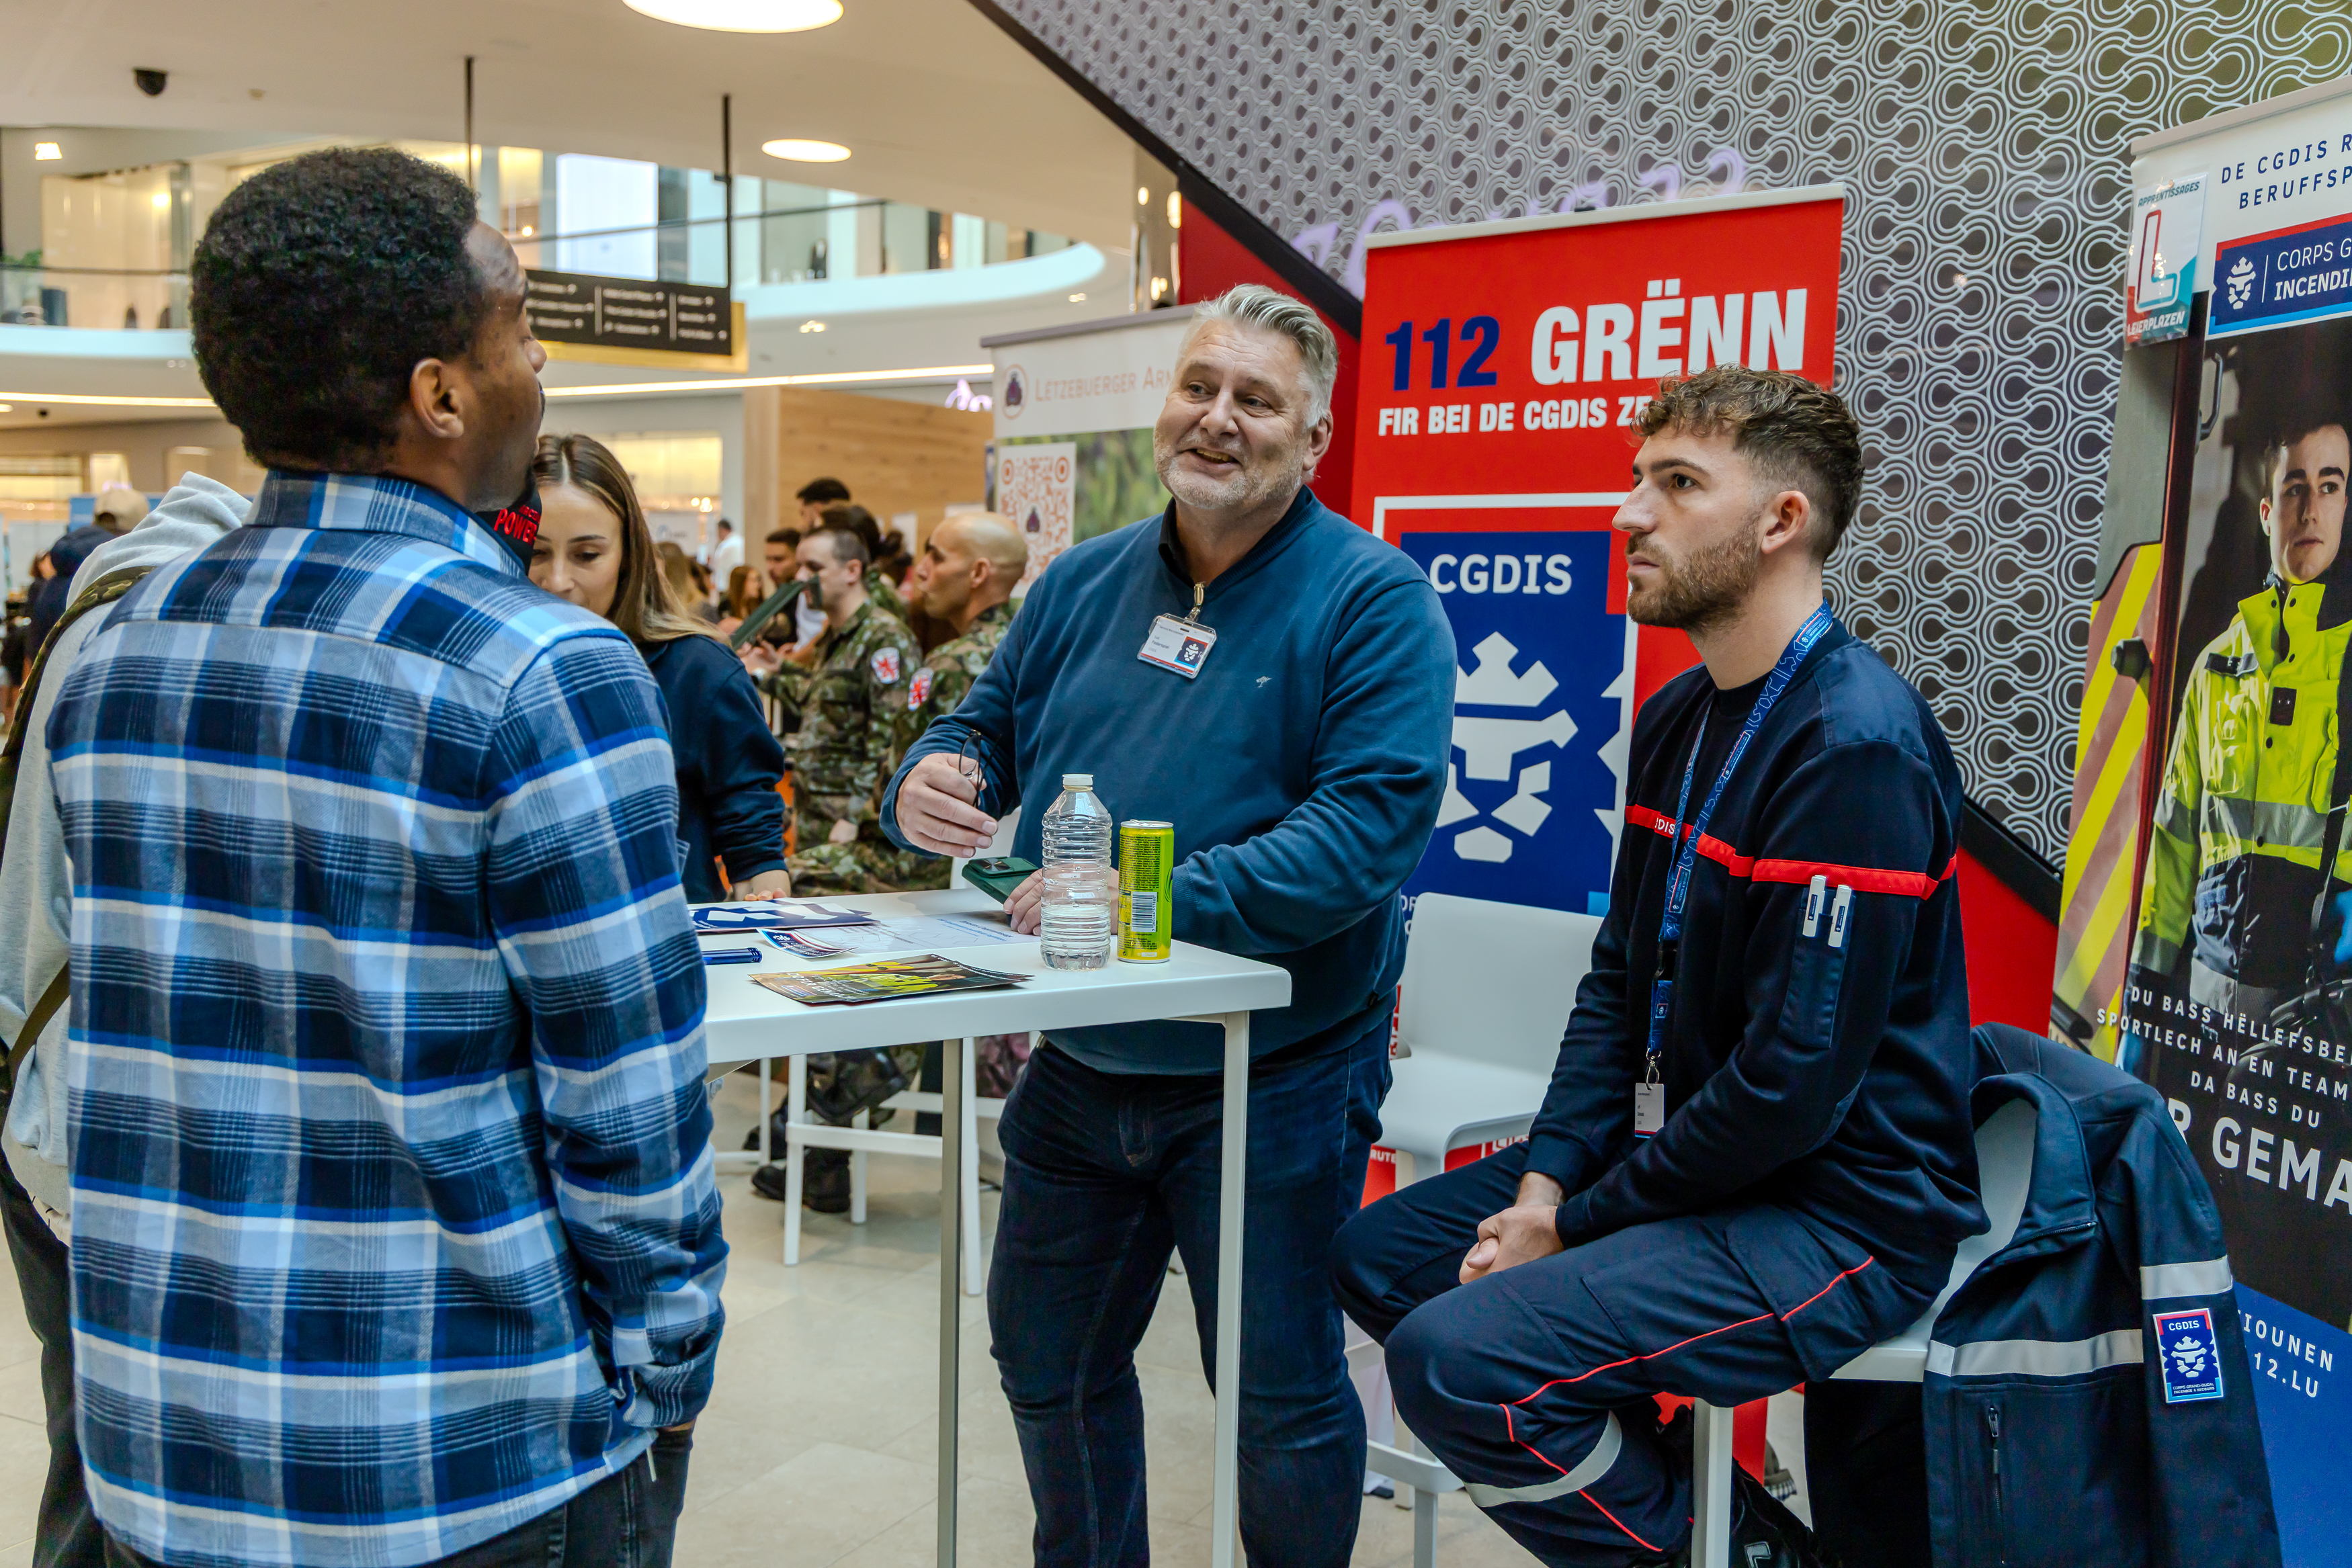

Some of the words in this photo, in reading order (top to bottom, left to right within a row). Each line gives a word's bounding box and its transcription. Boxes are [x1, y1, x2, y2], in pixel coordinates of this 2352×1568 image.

[2222, 163, 2244, 183] DE
[2257, 140, 2327, 174] CGDIS
[2138, 181, 2201, 207] APPRENTISSAGES
[2239, 166, 2352, 210] BERUFFSP
[2277, 242, 2333, 271] CORPS
[2274, 267, 2352, 301] INCENDI
[1385, 315, 1501, 392] 112
[1531, 277, 1808, 386] GRËNN
[2127, 310, 2185, 336] LEIERPLAZEN
[1378, 407, 1419, 436] FIR
[1427, 404, 1470, 434] BEI
[1479, 402, 1515, 432] DE
[1523, 397, 1607, 431] CGDIS
[1430, 554, 1572, 595] CGDIS
[2130, 986, 2152, 1006] DU
[2162, 996, 2212, 1024] BASS
[2223, 1013, 2352, 1065] HËLLEFSBE
[2097, 1008, 2201, 1055] SPORTLECH
[2212, 1044, 2238, 1066] AN
[2249, 1055, 2273, 1078] EN
[2287, 1067, 2348, 1101] TEAM
[2191, 1071, 2215, 1093] DA
[2226, 1082, 2278, 1115] BASS
[2292, 1104, 2320, 1129] DU
[2212, 1117, 2352, 1216] GEMA
[2169, 1320, 2199, 1331] CGDIS
[2238, 1309, 2333, 1372] IOUNEN
